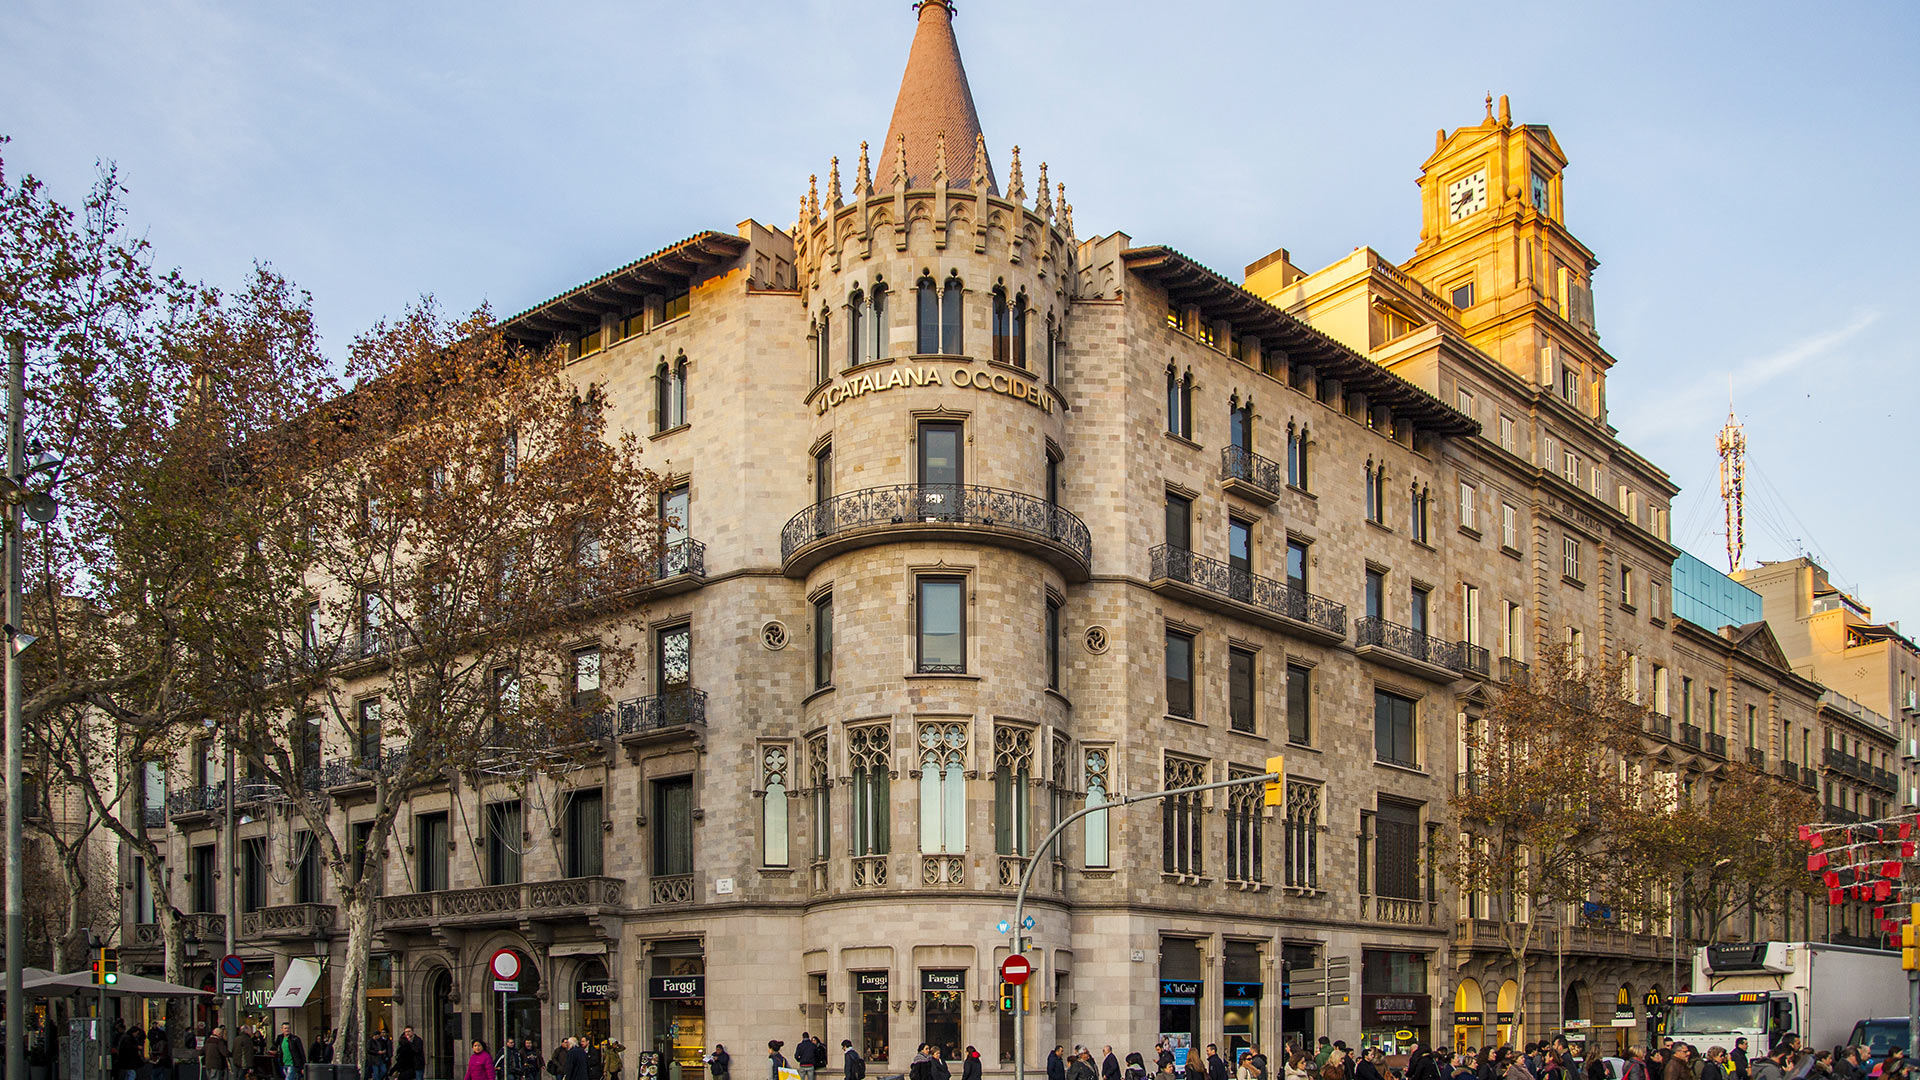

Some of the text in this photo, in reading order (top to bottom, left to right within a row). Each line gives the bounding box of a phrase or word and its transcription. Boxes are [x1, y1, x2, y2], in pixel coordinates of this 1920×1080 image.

[828, 366, 943, 407] CATALANA
[663, 979, 696, 994] Farggi
[861, 975, 888, 986] Farggi
[928, 974, 959, 985] Farggi
[581, 981, 608, 995] Fargg
[245, 990, 263, 1006] PUNT
